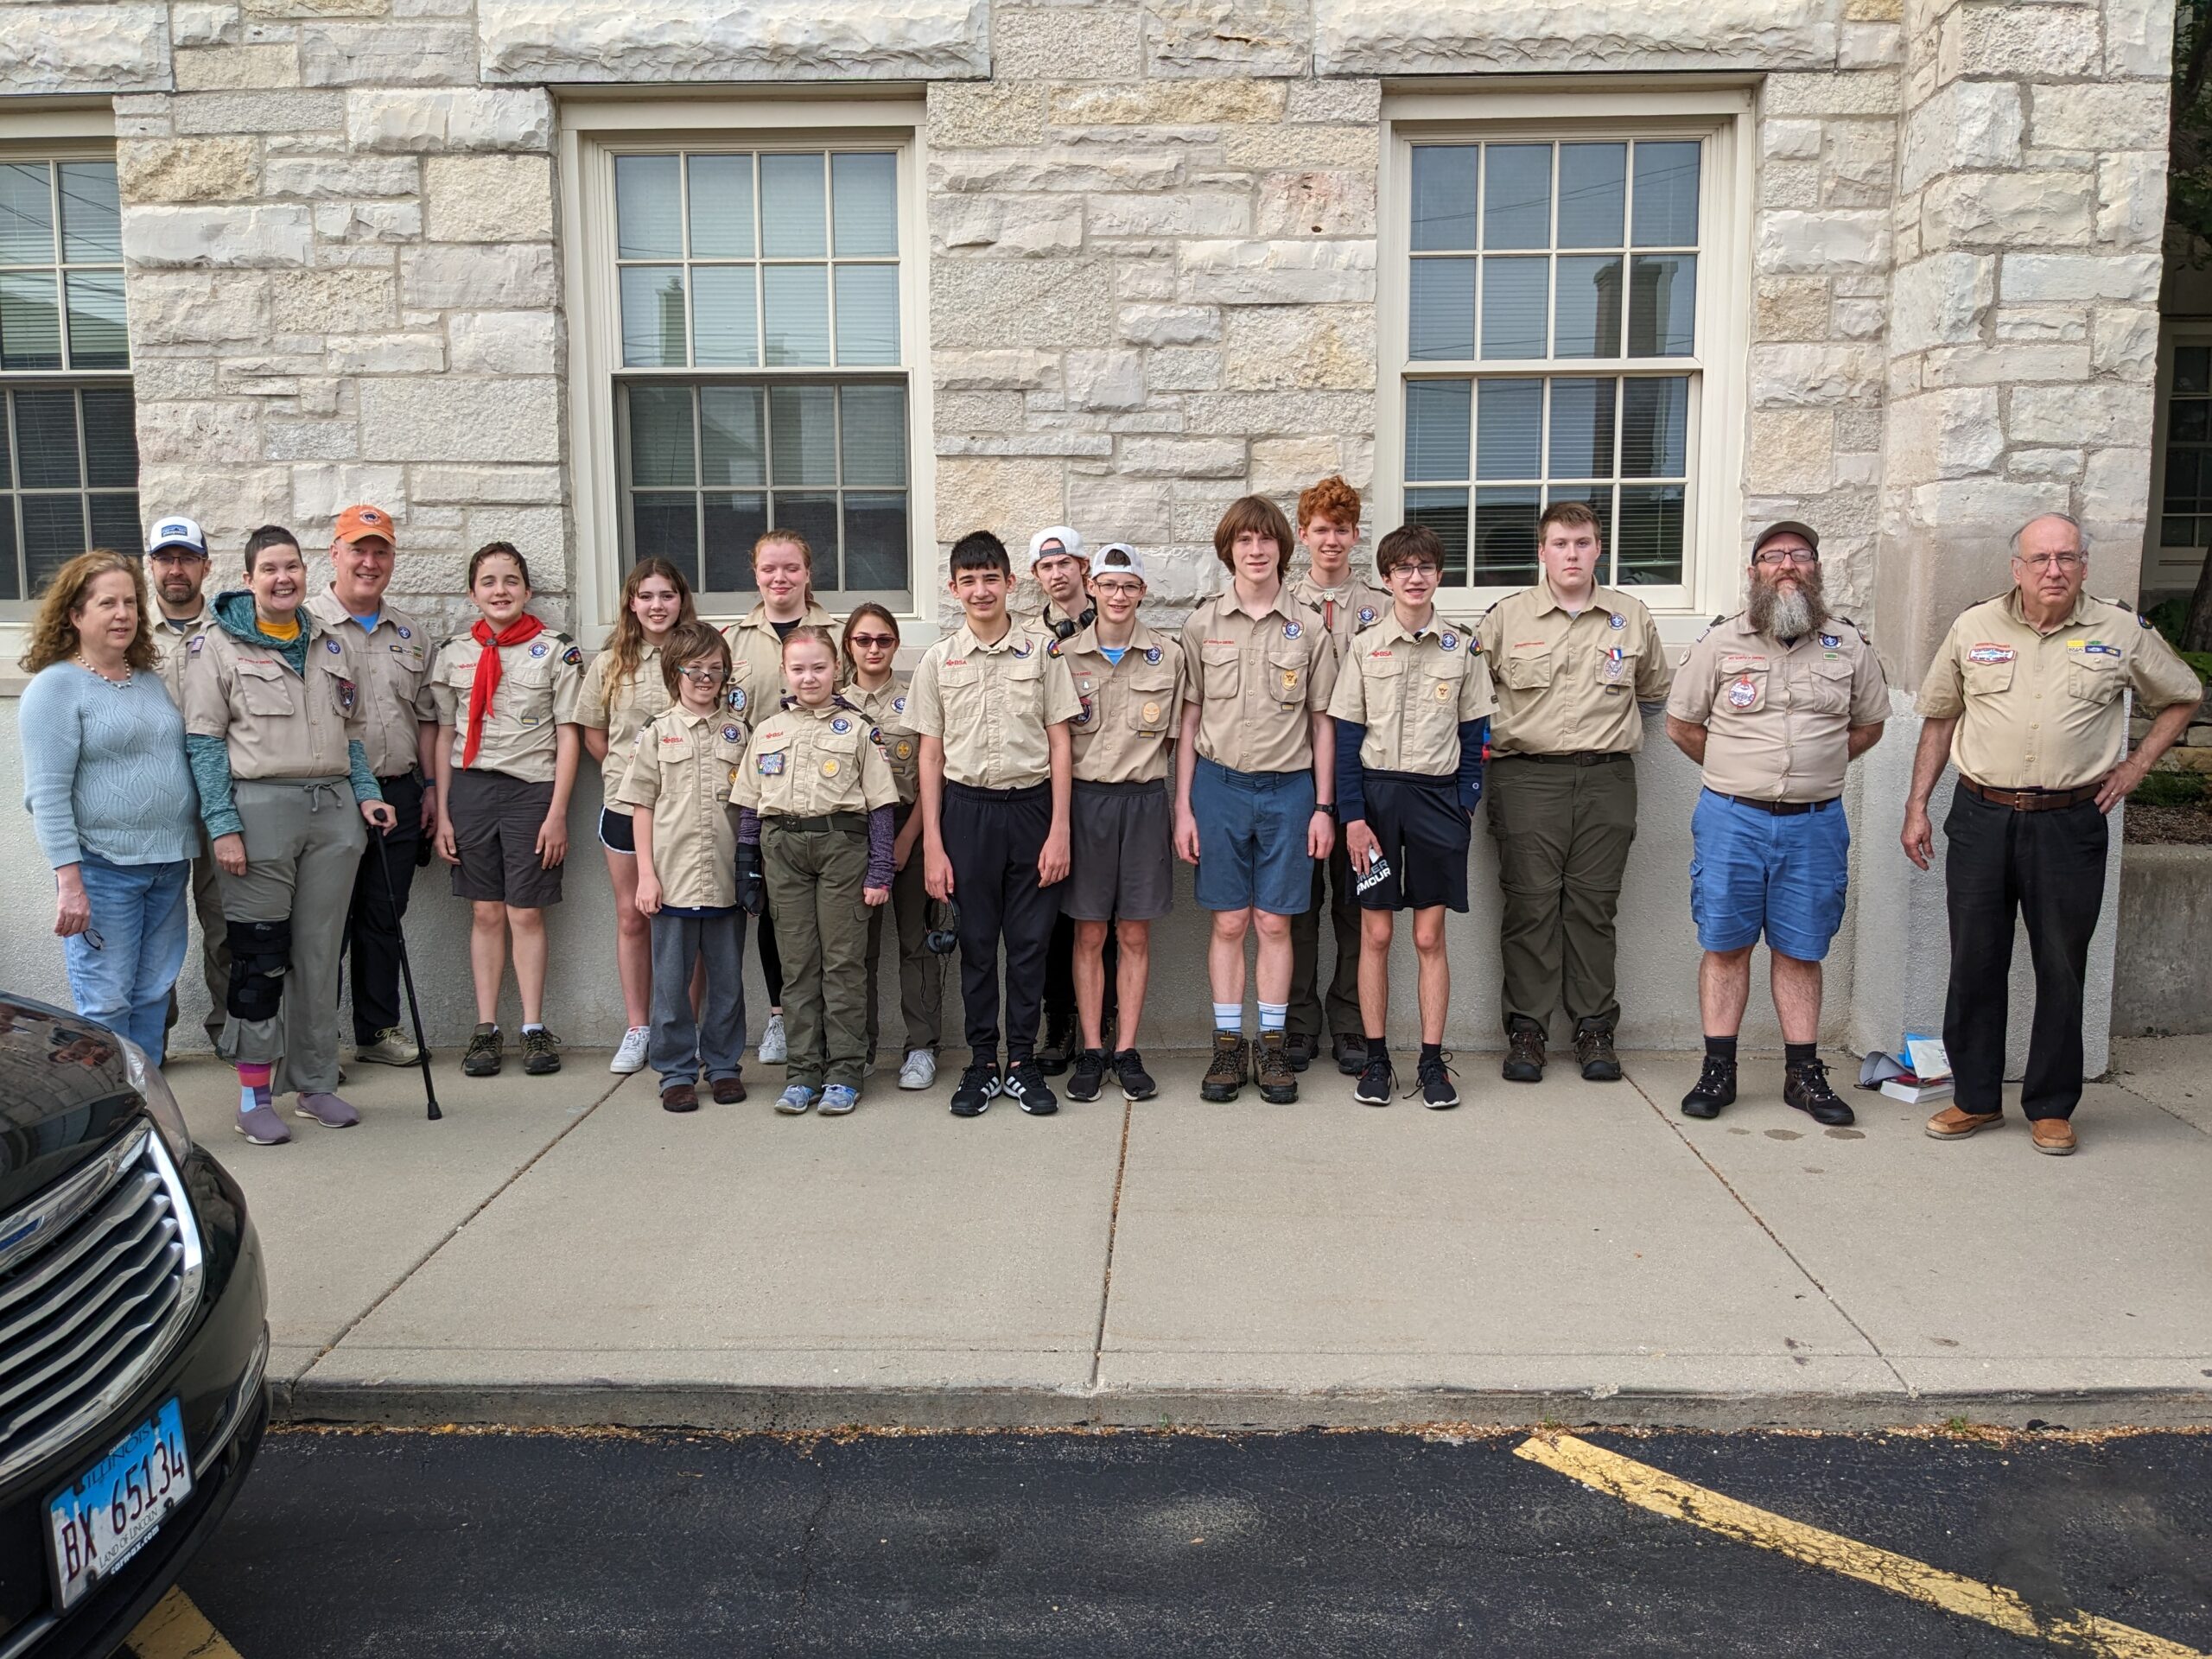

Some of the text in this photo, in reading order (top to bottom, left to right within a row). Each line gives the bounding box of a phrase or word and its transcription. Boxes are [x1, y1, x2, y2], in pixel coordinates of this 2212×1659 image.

[1356, 859, 1389, 884] UNER
[87, 1427, 150, 1489] ILLINOIS
[61, 1431, 185, 1584] BX 65134
[99, 1507, 158, 1569] LAND OF LINCOLN
[111, 1524, 160, 1575] carmax.com
